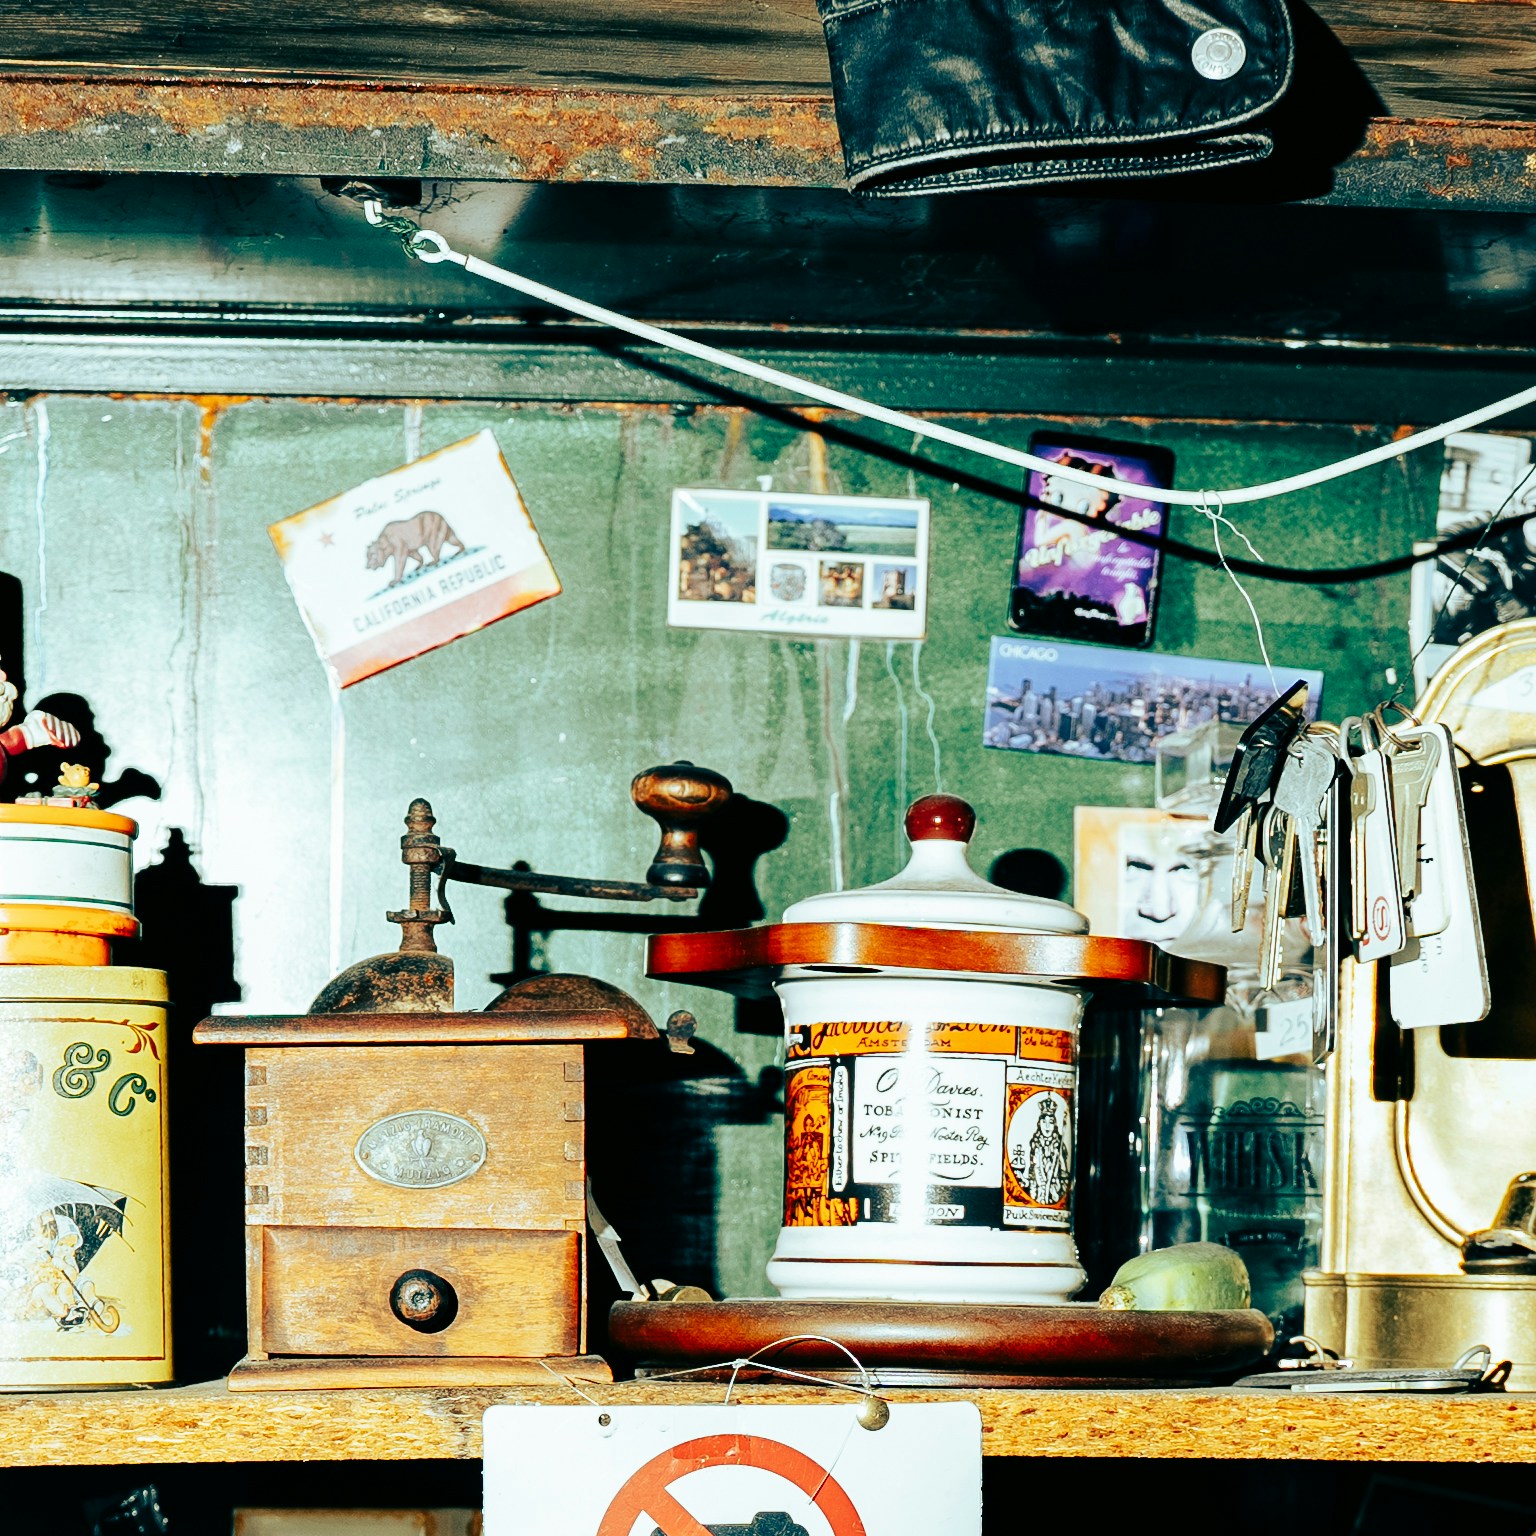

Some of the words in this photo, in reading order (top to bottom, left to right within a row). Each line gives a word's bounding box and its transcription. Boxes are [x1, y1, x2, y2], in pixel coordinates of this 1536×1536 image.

[352, 586, 437, 632] CALIFORNIA
[439, 554, 505, 594] REPUBLIC
[998, 643, 1059, 664] CHICAGO
[53, 1041, 110, 1099] &
